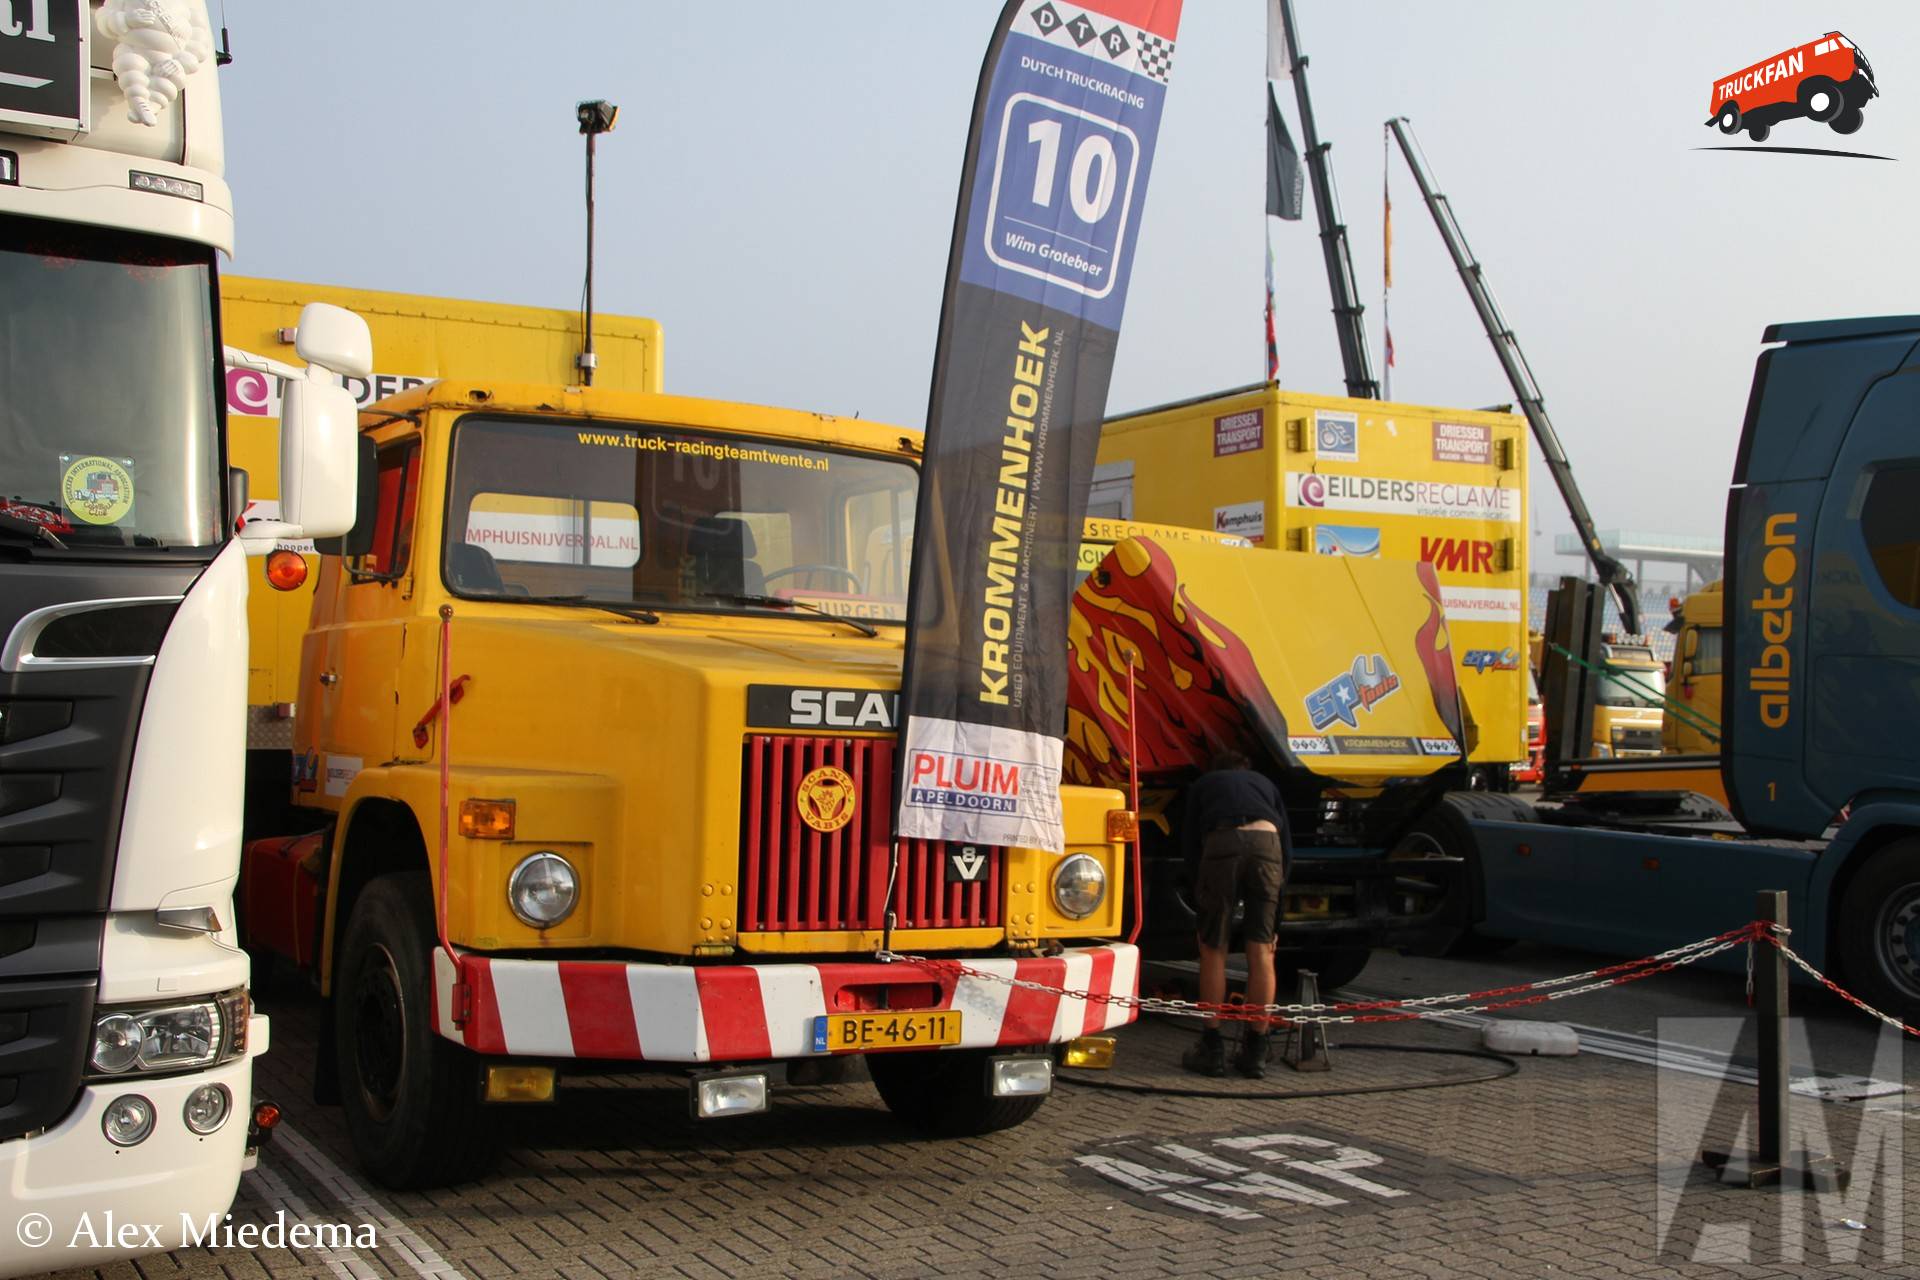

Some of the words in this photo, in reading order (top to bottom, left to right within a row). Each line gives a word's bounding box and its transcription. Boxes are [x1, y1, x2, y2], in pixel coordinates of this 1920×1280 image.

[1020, 55, 1064, 80] DUTCH
[1065, 70, 1145, 109] TRUCKRACING
[1028, 119, 1117, 224] 10
[1005, 231, 1037, 254] Wim
[1038, 243, 1103, 277] Groteboer
[577, 431, 829, 472] www.truck-racingteamtwente.nl
[1216, 425, 1261, 446] TRANSPORT
[1435, 438, 1489, 455] TRANSPORT
[1440, 424, 1485, 440] DRIESSEN
[979, 319, 1050, 706] KROMMENHOEK
[1021, 503, 1040, 579] MACHINERY
[1420, 536, 1494, 575] VMR
[1012, 596, 1028, 673] EQUIPMENT
[790, 689, 899, 728] SCA
[1012, 674, 1023, 708] USED
[802, 769, 853, 795] SCANIA
[911, 752, 1021, 796] PLUIM
[1766, 782, 1776, 801] 1
[914, 790, 1013, 812] APELDOORN
[804, 813, 850, 830] VABIS
[814, 1036, 826, 1046] NL
[842, 1016, 947, 1045] BE-46-11
